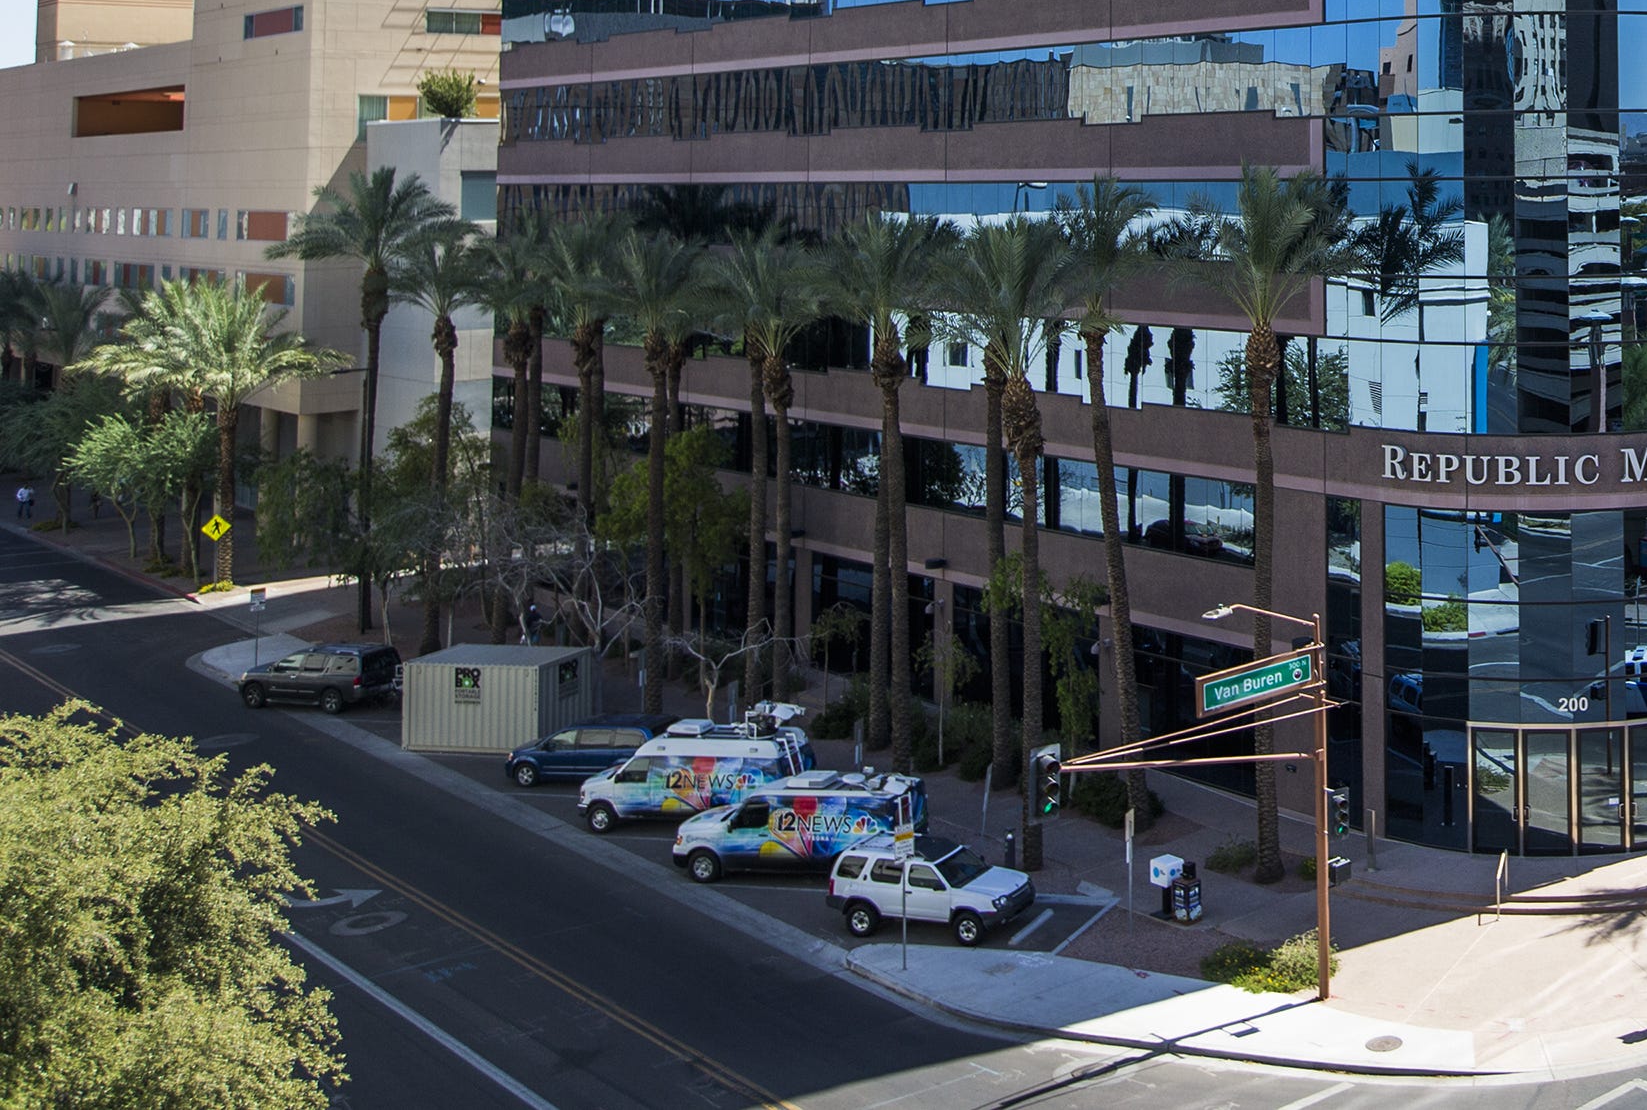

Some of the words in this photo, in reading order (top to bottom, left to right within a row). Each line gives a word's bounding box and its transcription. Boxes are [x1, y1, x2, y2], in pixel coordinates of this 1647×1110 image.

[1381, 445, 1600, 486] REPUBLIC
[455, 667, 481, 678] PRO
[1214, 684, 1239, 701] Van
[1243, 671, 1283, 692] Buren
[1558, 697, 1588, 712] 200
